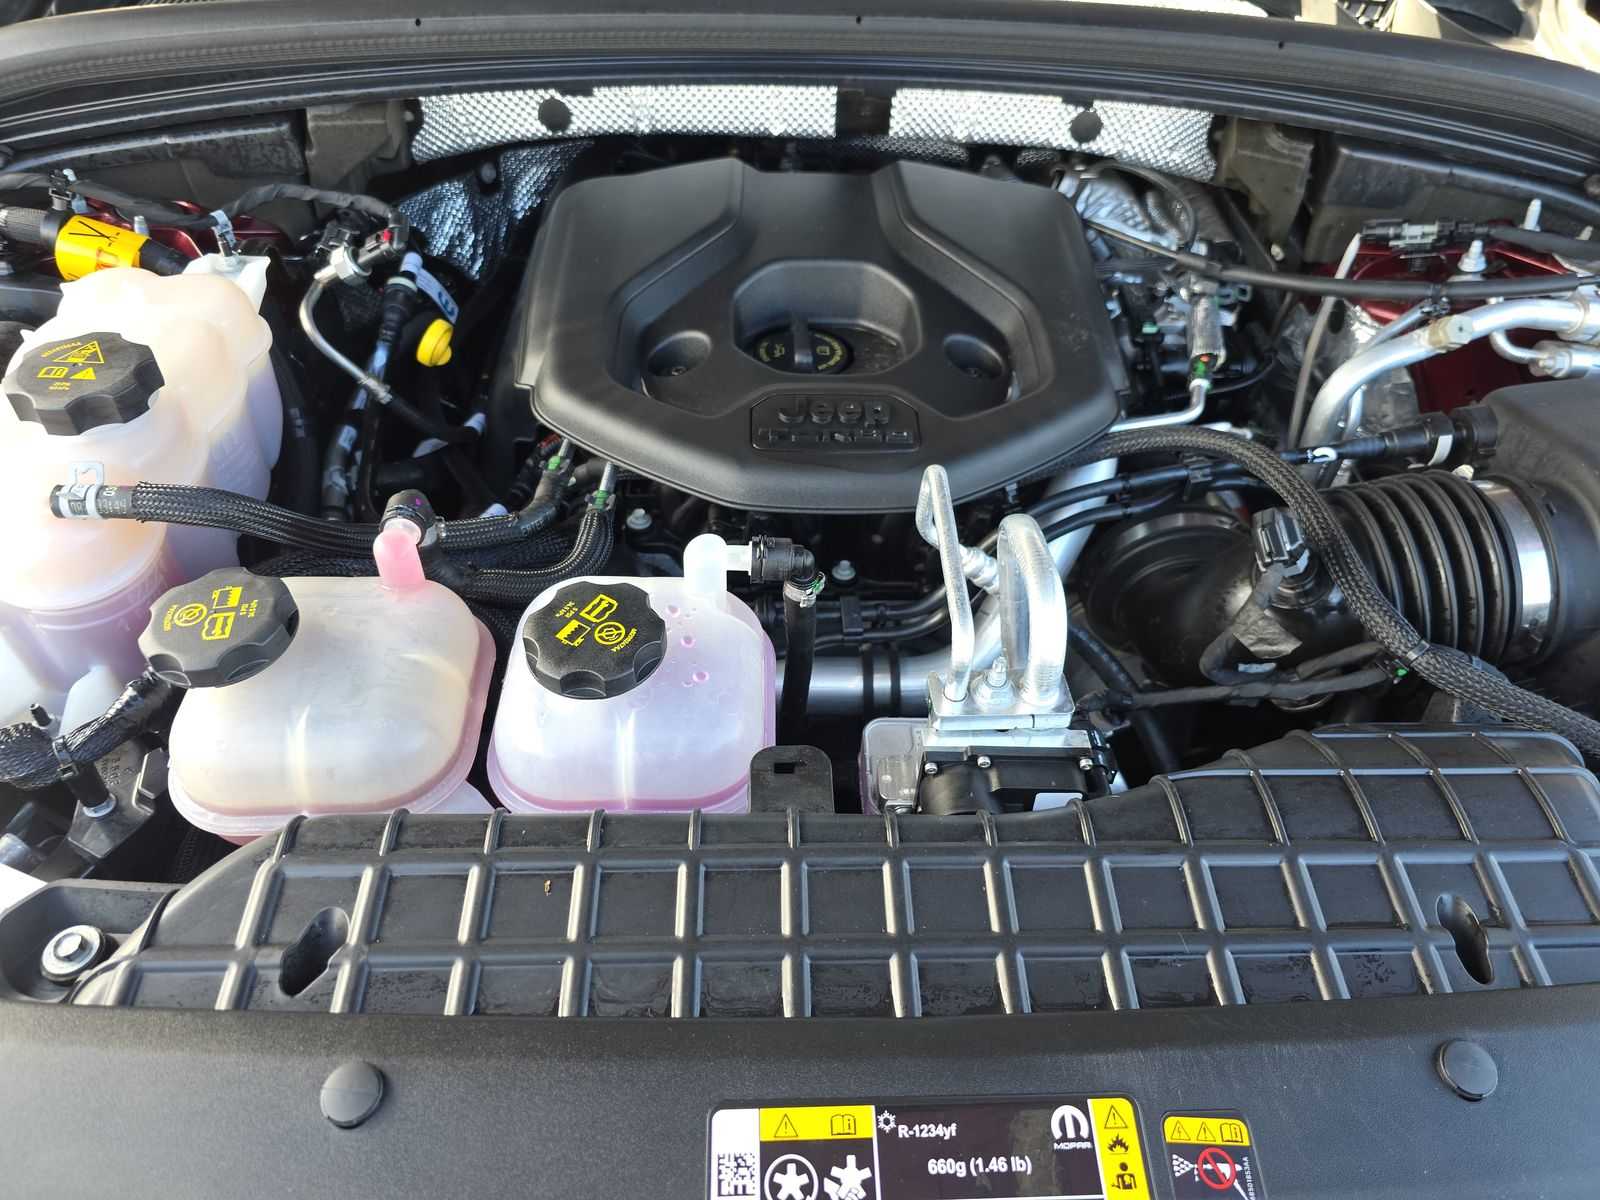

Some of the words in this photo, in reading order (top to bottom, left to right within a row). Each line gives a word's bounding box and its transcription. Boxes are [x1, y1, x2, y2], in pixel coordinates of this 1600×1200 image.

[777, 397, 891, 428] Jeep
[898, 1123, 957, 1140] R-1234yf
[1053, 1141, 1092, 1150] MOPAR
[928, 1158, 967, 1177] 660g
[970, 1156, 1007, 1177] (1.46
[1011, 1155, 1032, 1175] lb)
